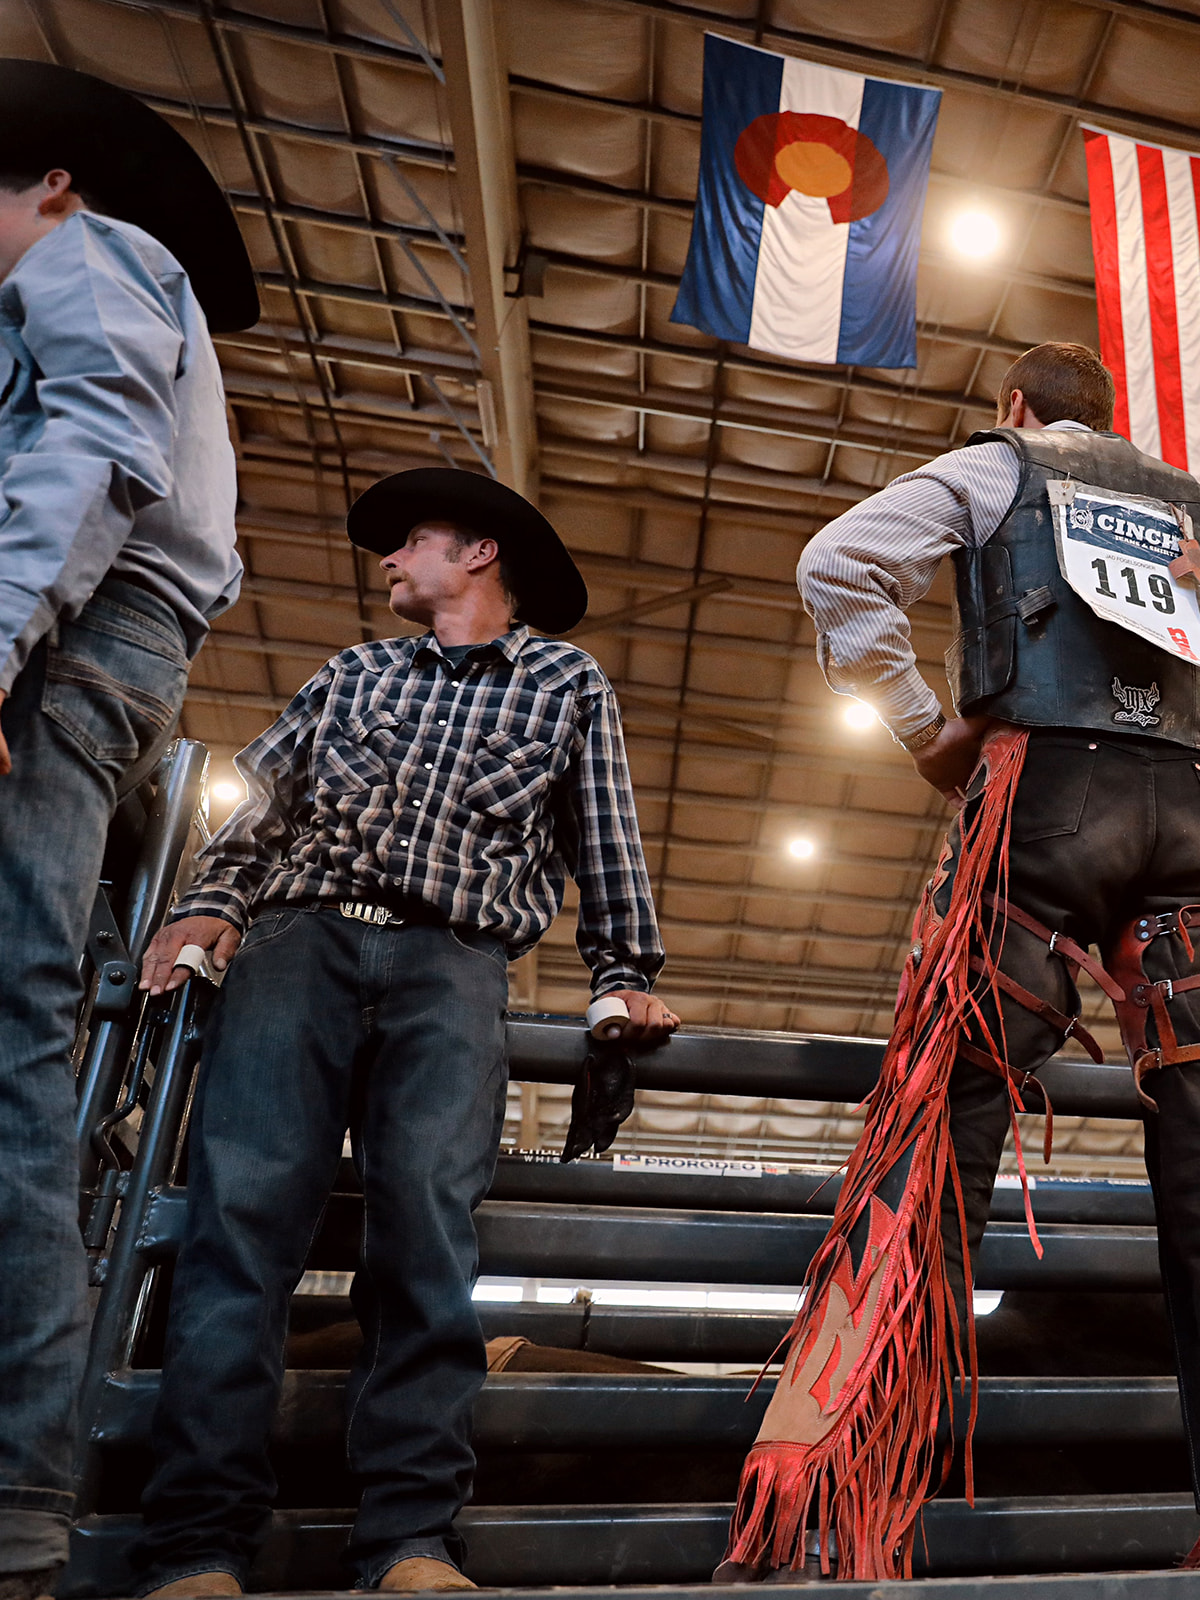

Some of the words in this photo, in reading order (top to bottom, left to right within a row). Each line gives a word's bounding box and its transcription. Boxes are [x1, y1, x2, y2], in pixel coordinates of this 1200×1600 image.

[1097, 513, 1181, 552] CINCH
[1114, 534, 1141, 547] JEANS
[1091, 557, 1176, 616] 119
[523, 1155, 581, 1165] WHISY
[644, 1157, 756, 1171] PRORODEO
